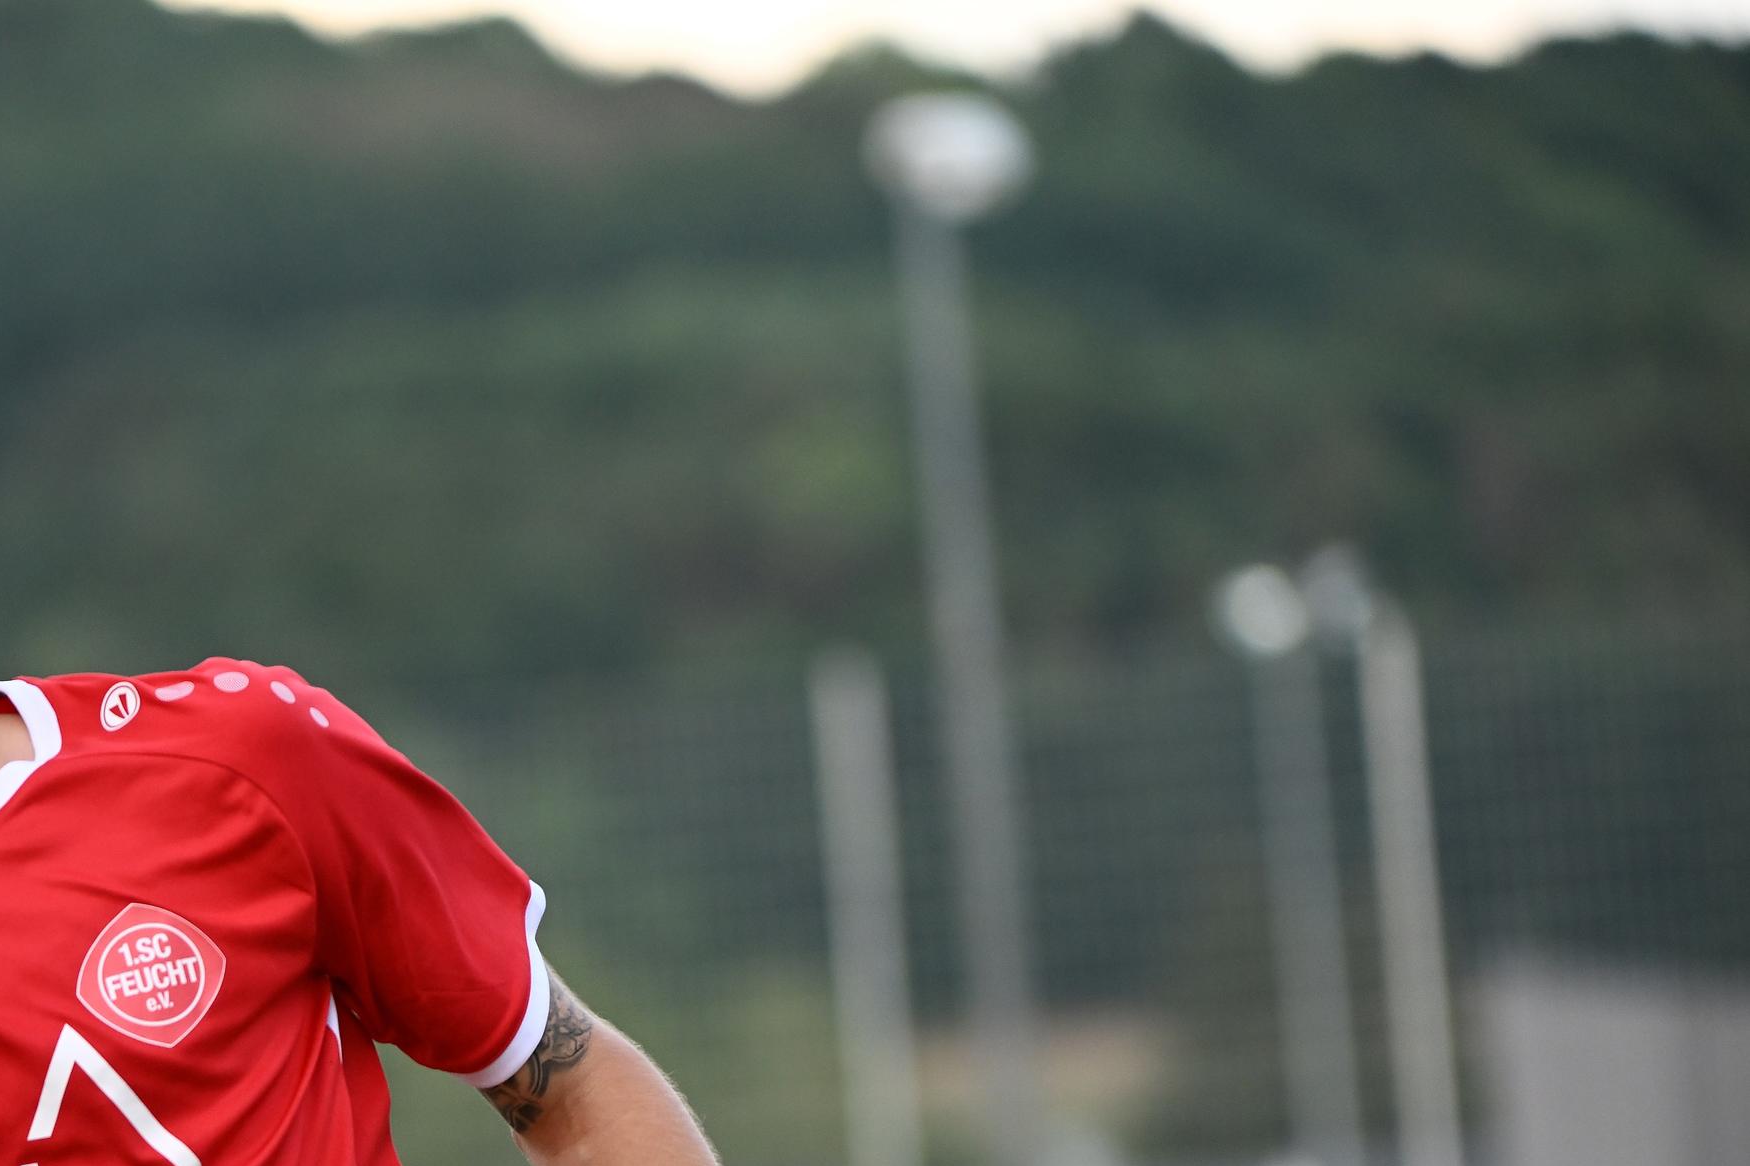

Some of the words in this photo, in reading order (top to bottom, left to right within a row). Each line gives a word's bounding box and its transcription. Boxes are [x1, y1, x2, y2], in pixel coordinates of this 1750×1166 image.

[118, 932, 172, 967] 1.SC
[105, 956, 198, 1001] FEUCHT
[146, 990, 174, 1012] e.V.
